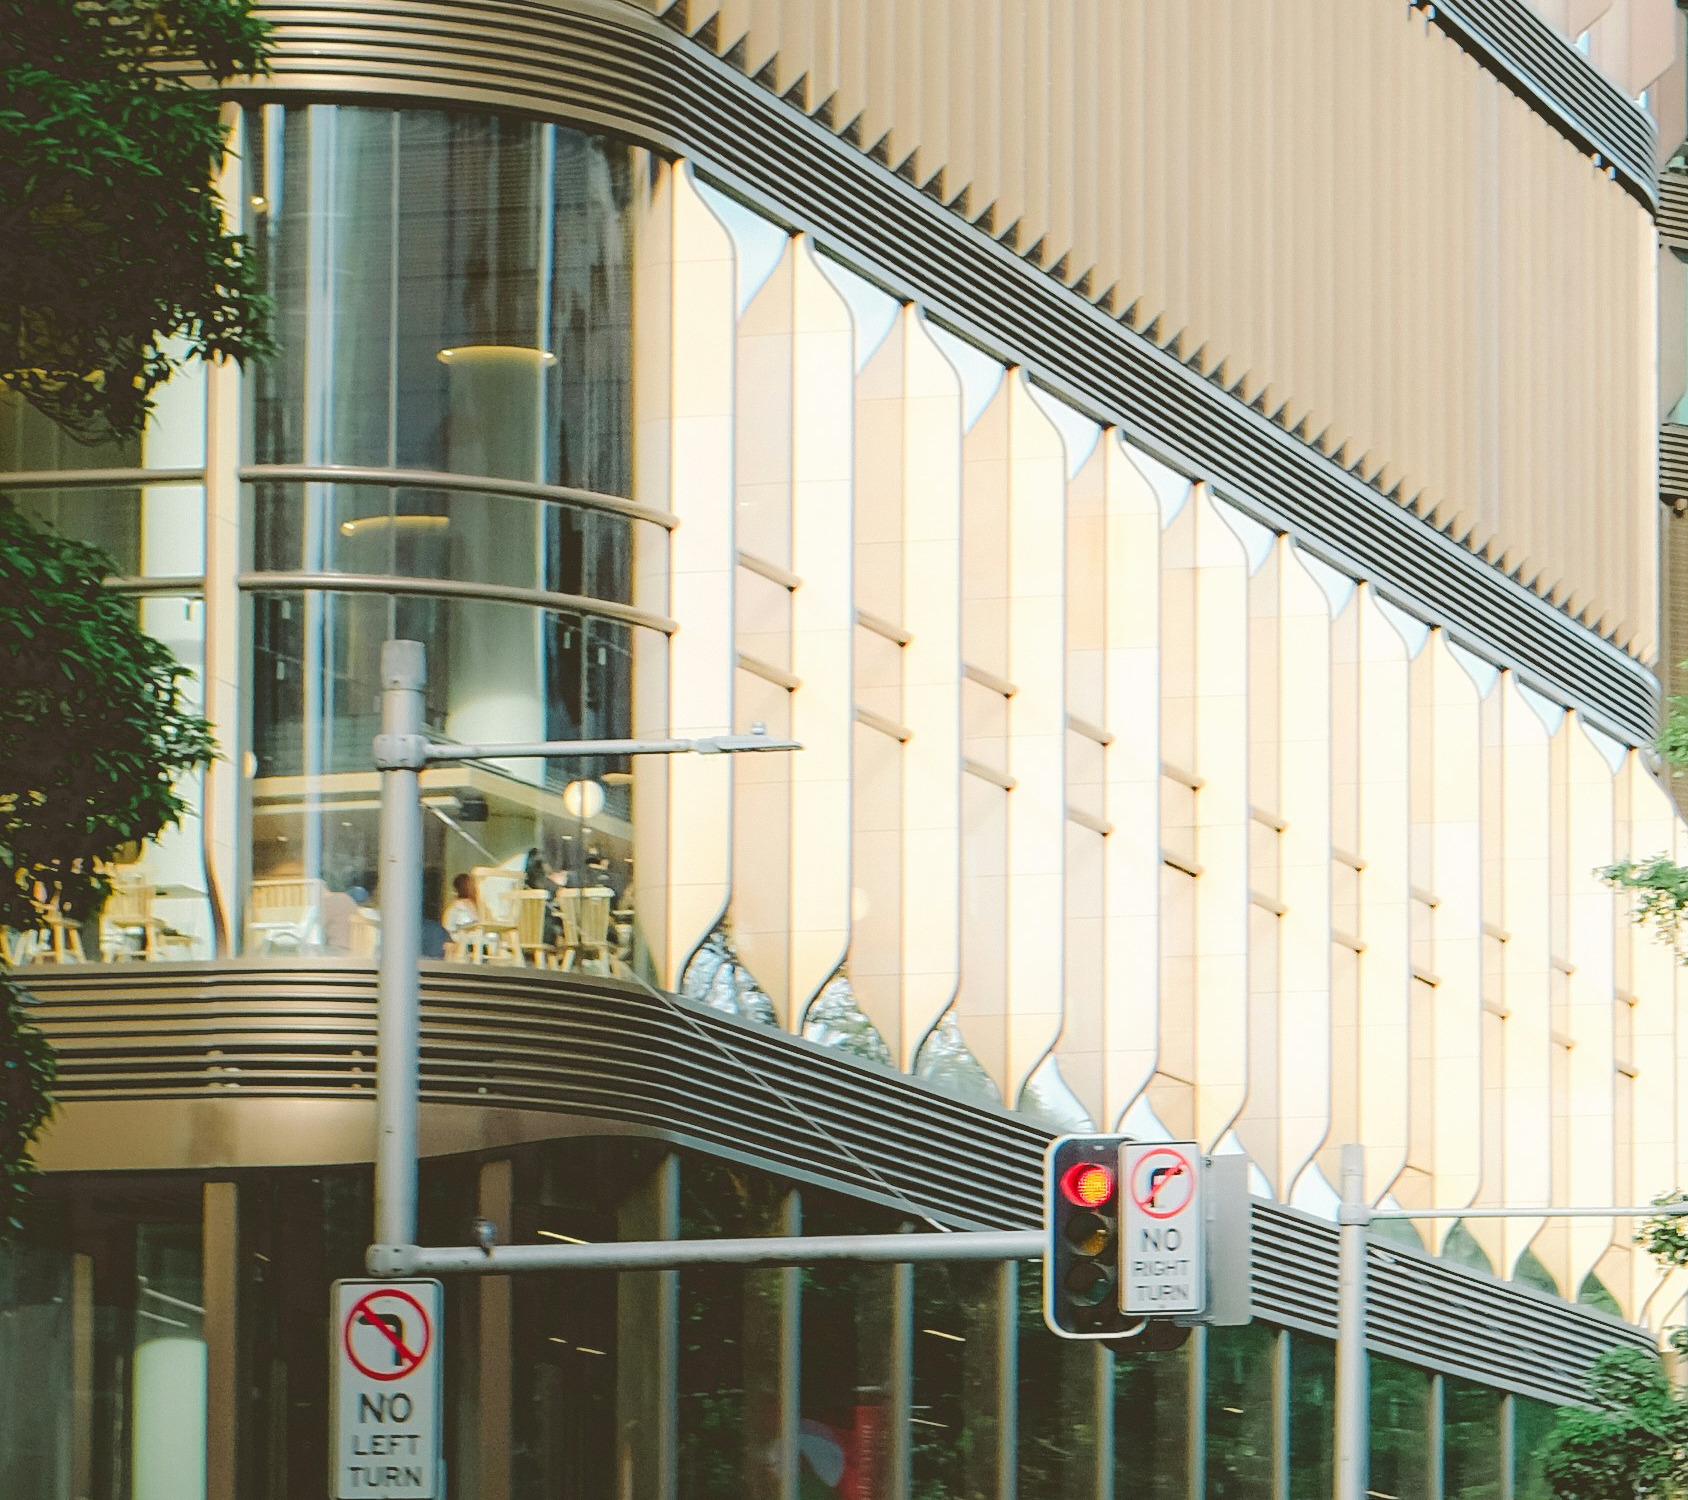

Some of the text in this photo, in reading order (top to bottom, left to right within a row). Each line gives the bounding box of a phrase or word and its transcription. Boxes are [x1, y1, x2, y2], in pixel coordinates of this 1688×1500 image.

[1140, 1227, 1182, 1252] NO
[1132, 1259, 1190, 1277] RIGHT
[1135, 1284, 1190, 1301] TURN
[358, 1392, 412, 1423] NO
[352, 1434, 420, 1455] LEFT
[347, 1466, 423, 1488] TURN
